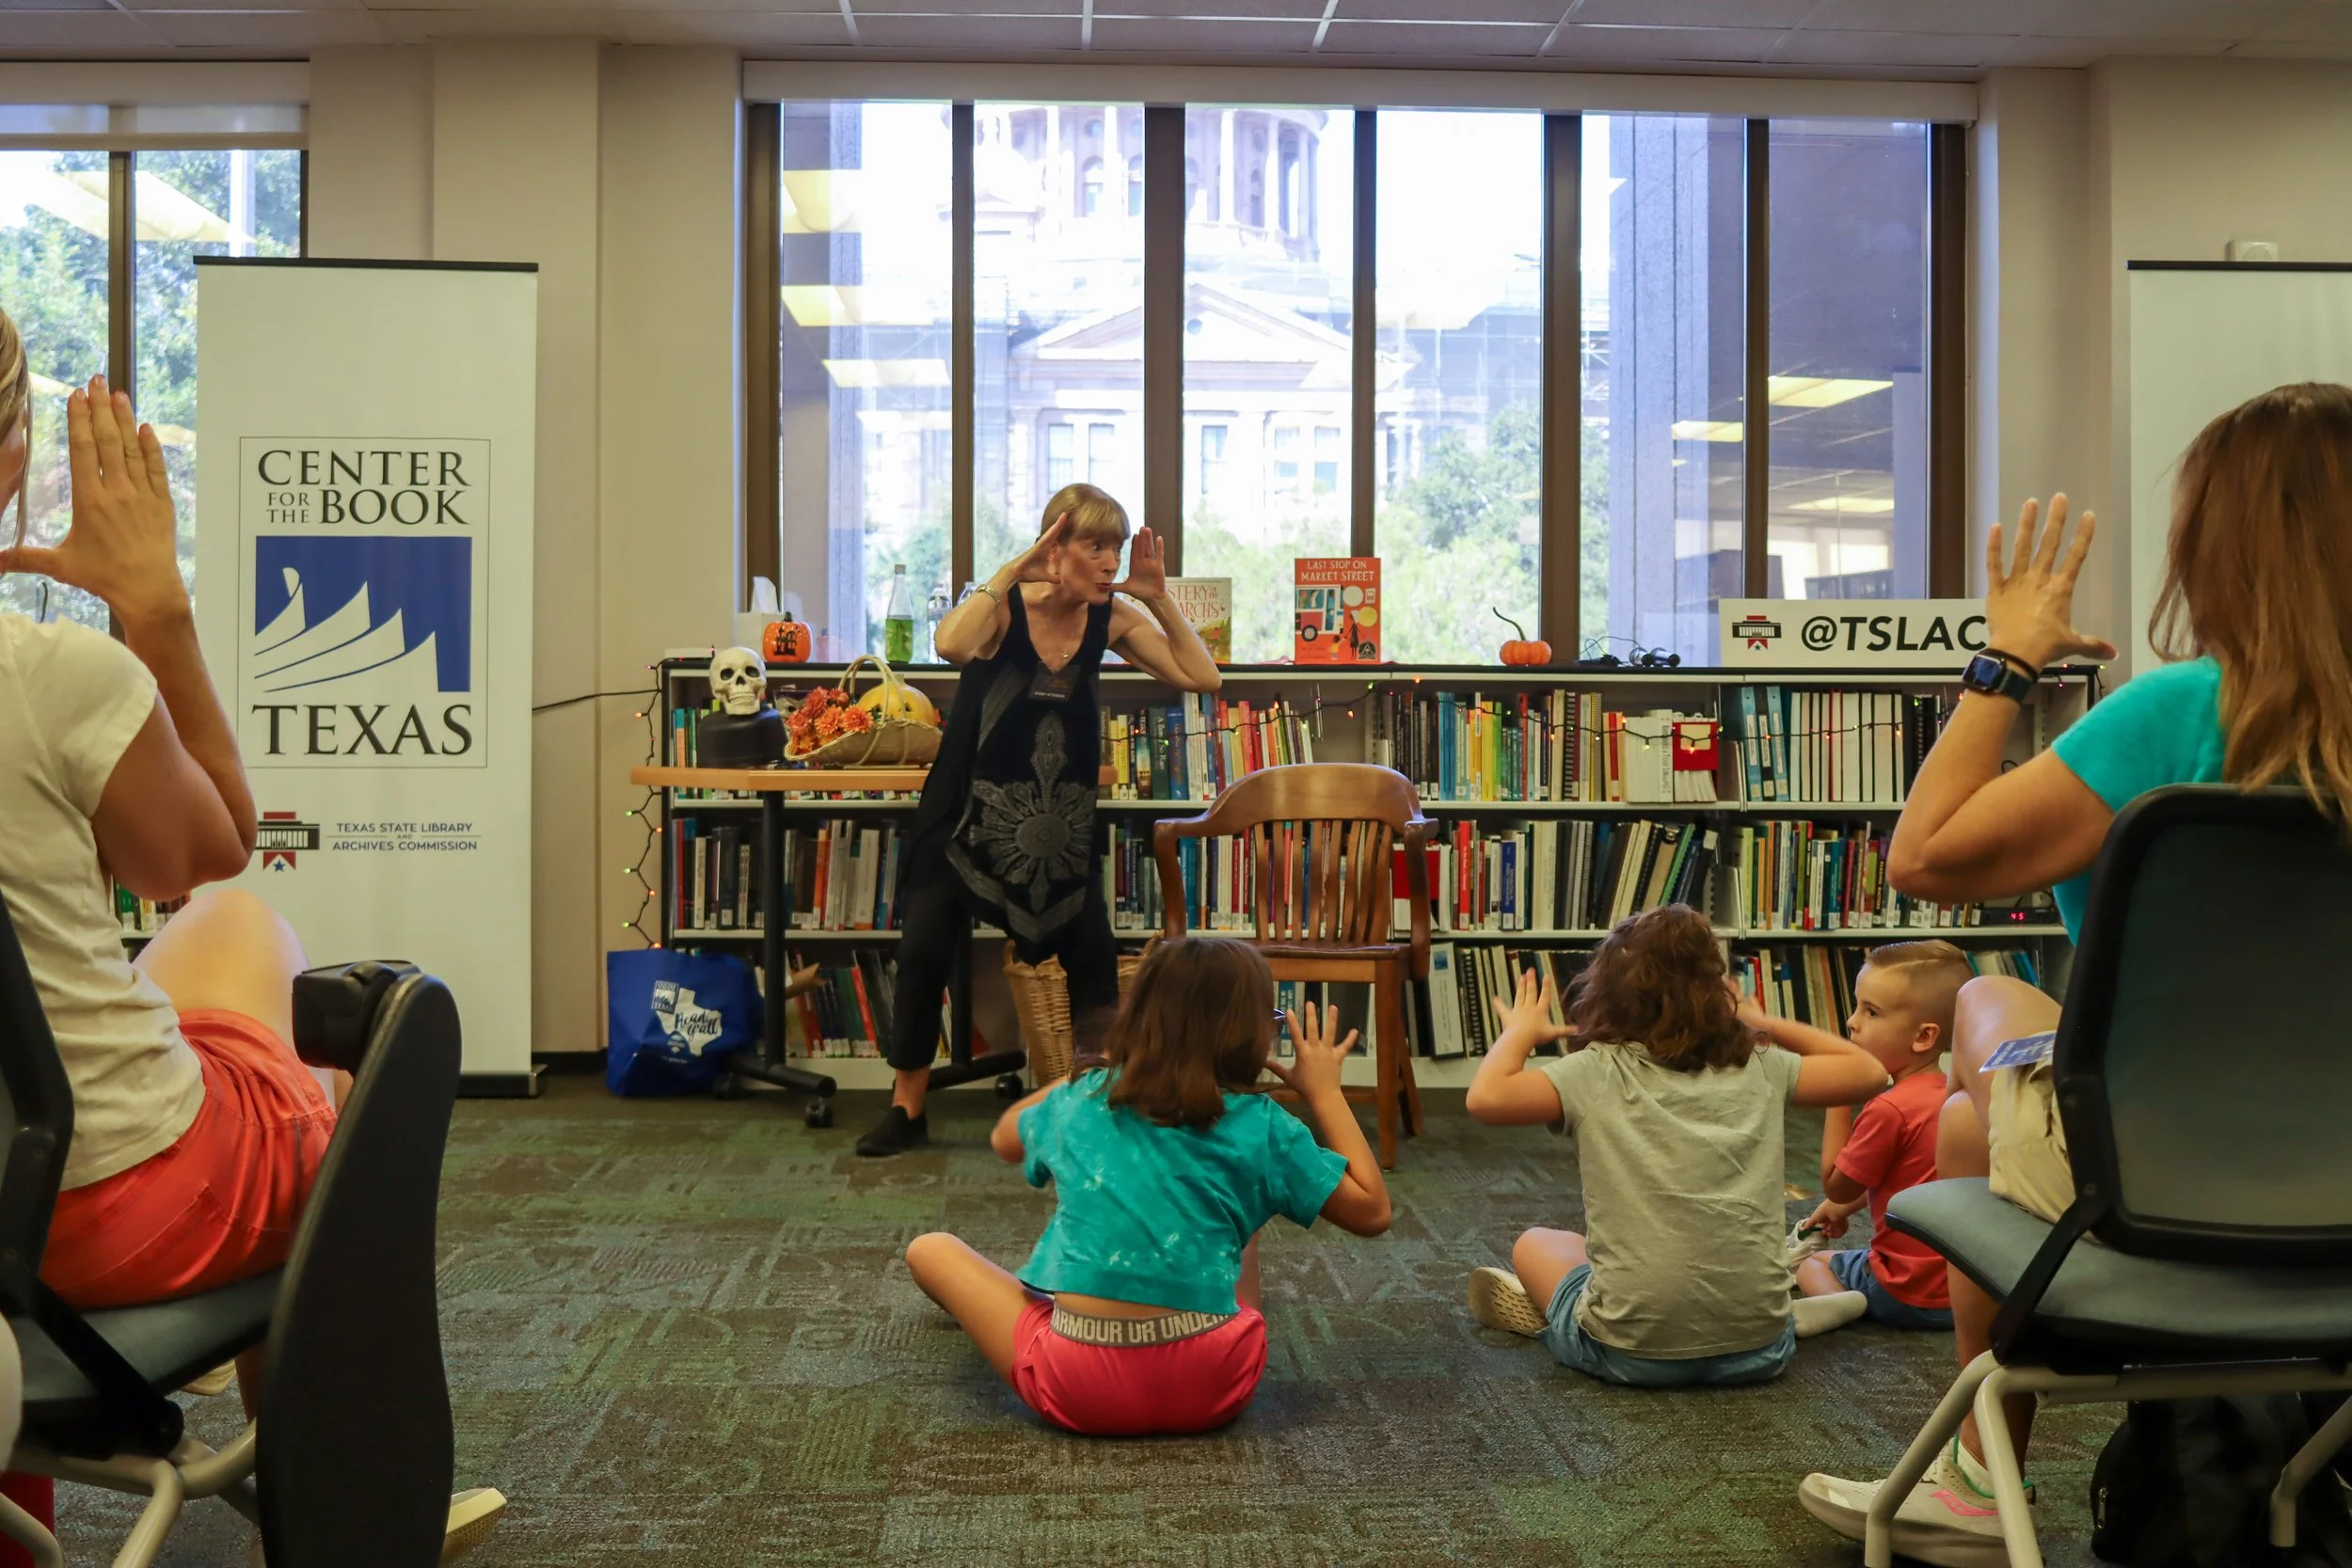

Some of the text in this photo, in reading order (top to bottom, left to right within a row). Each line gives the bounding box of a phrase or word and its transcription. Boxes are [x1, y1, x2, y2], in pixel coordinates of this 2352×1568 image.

[258, 450, 472, 486] CENTER
[267, 492, 310, 506] FOR
[319, 489, 471, 525] BOOK
[266, 509, 310, 524] THE
[1308, 560, 1367, 570] LAST STOP ON
[1301, 570, 1375, 582] MARKET STREET
[1168, 585, 1209, 600] STERY
[1801, 615, 1987, 651] @TSLAC
[251, 704, 472, 755] TEXAS
[337, 823, 472, 832] TEXAS STATE LIBRARY
[332, 841, 478, 850] ARCHIVES COMMISSION
